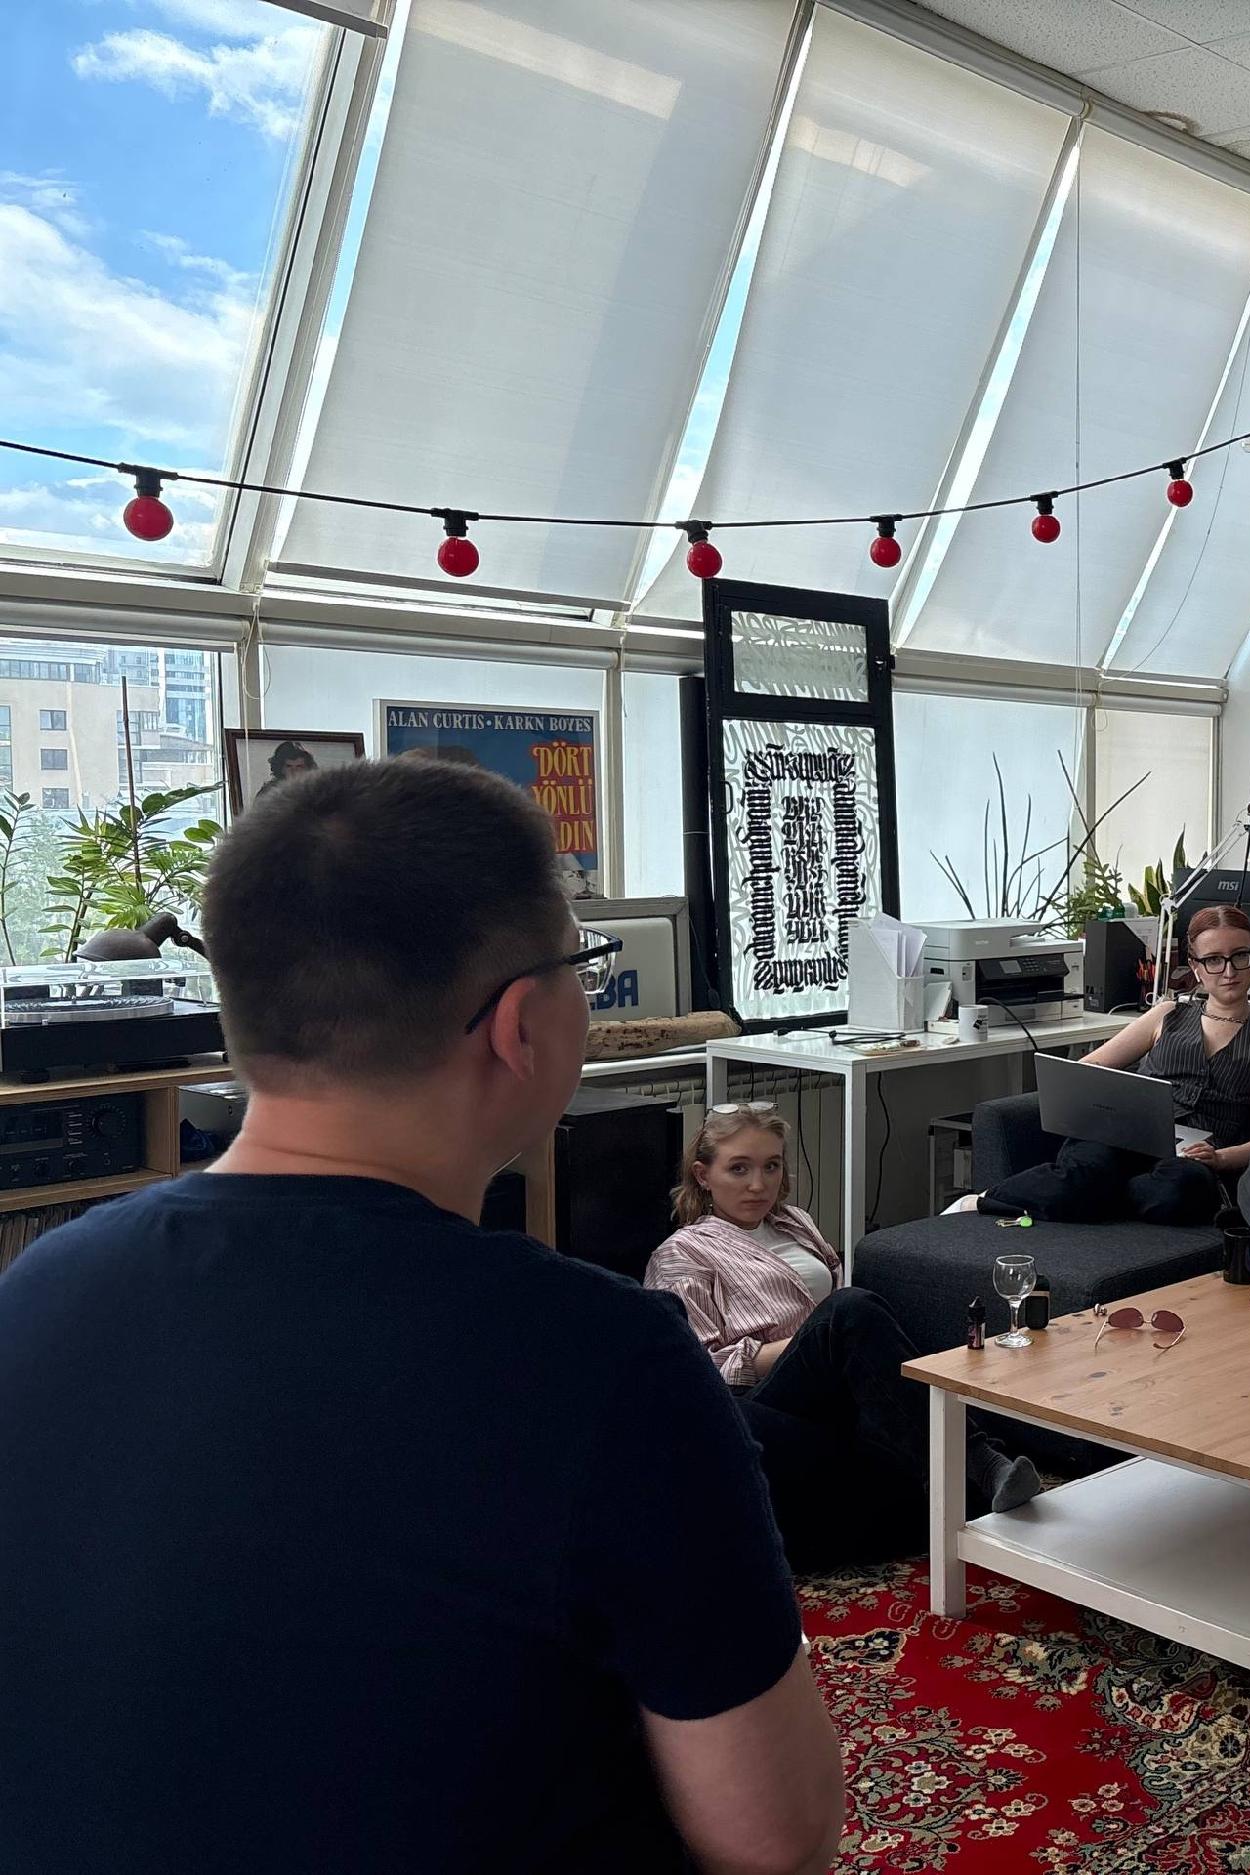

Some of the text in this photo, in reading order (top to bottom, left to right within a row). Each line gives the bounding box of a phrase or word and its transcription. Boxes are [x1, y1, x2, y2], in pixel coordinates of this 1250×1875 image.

[388, 711, 428, 728] ALAN
[550, 717, 592, 733] BOYES
[533, 741, 592, 777] DÖRT
[555, 821, 593, 851] DIN
[1217, 880, 1240, 891] msi
